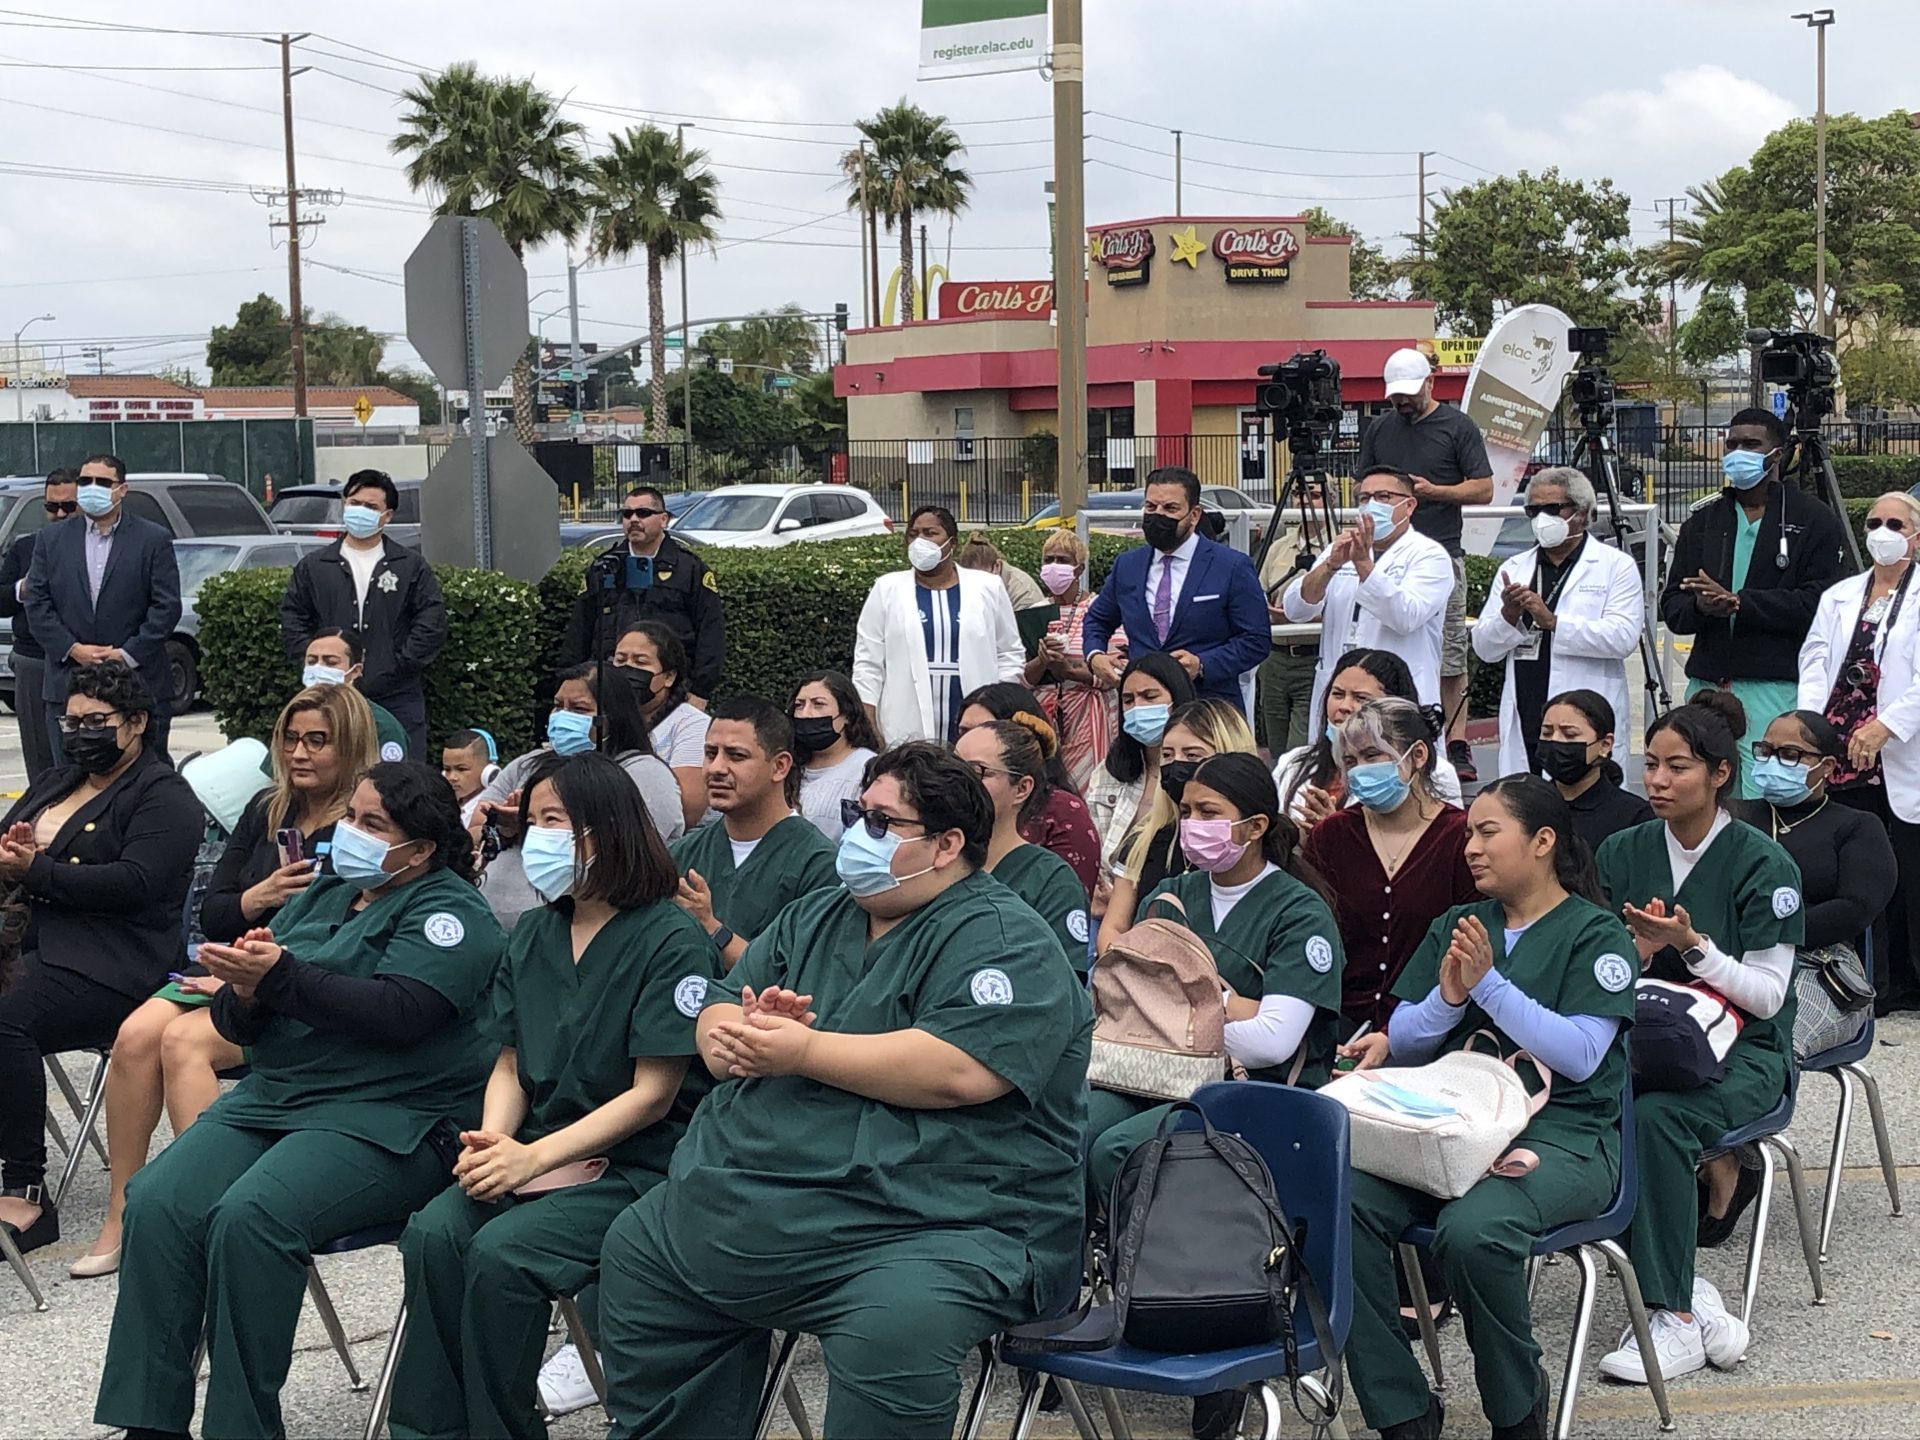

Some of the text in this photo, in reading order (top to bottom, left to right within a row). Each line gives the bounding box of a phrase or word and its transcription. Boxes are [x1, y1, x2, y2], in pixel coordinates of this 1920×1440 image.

[933, 37, 1034, 60] register.elac.edu
[1101, 233, 1129, 258] Carl's
[1219, 228, 1298, 254] Carl's Jr.
[1231, 268, 1288, 278] DRIVE THRU
[957, 284, 1053, 314] Carl's J
[1441, 341, 1464, 351] OPEN
[1502, 343, 1533, 361] elac
[1455, 355, 1462, 363] &
[1480, 393, 1544, 418] ADMINISTRATION
[1504, 409, 1516, 418] OF
[1491, 415, 1523, 430] JUSTICE
